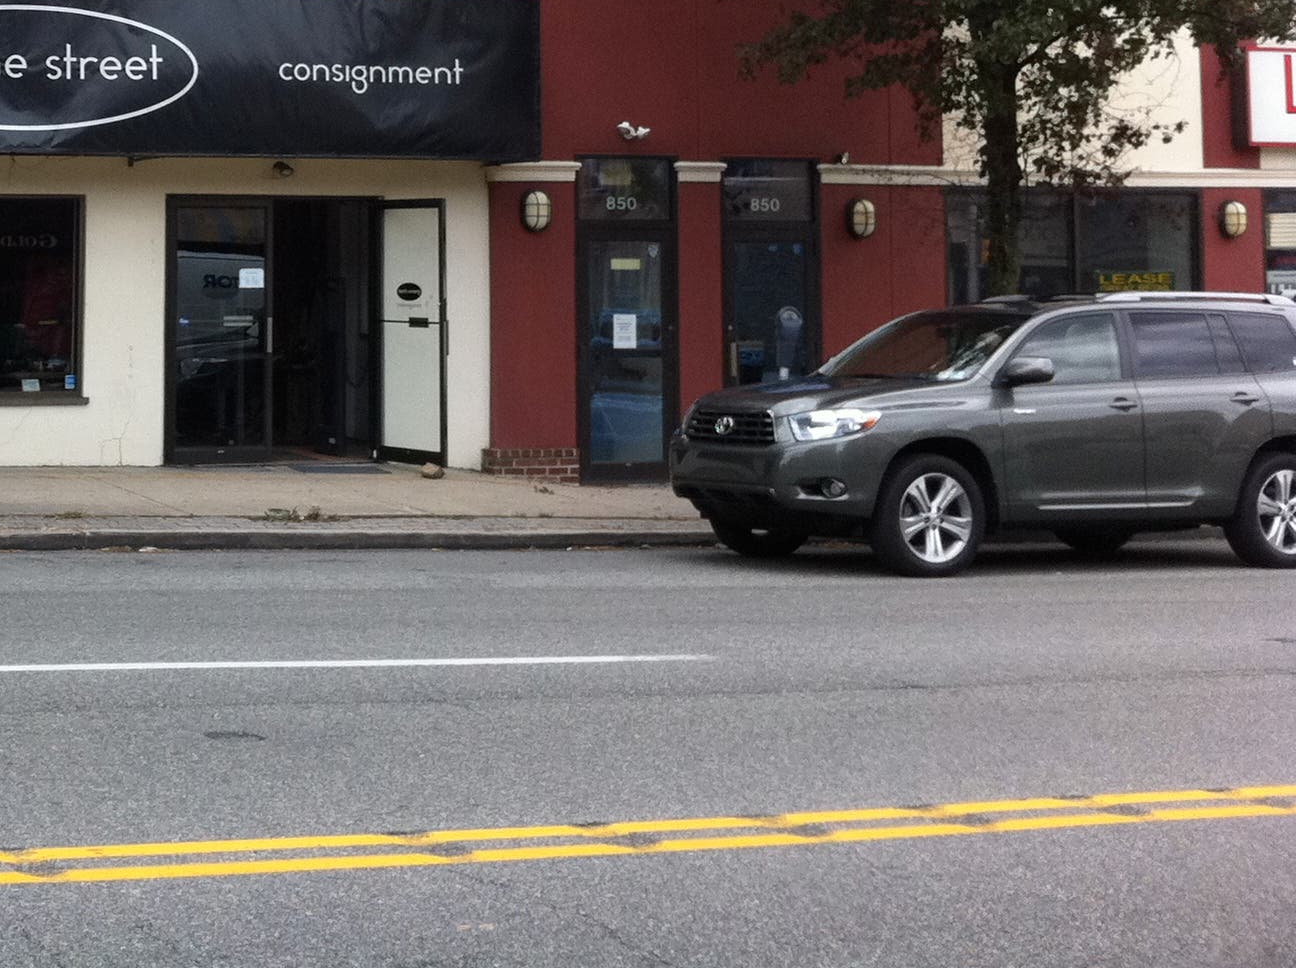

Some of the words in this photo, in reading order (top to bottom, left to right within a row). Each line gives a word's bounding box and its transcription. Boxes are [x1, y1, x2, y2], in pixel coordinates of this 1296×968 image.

[45, 43, 163, 81] street
[278, 58, 464, 94] consignment
[606, 196, 637, 210] 850
[750, 198, 780, 211] 850
[1100, 272, 1171, 285] LEASE
